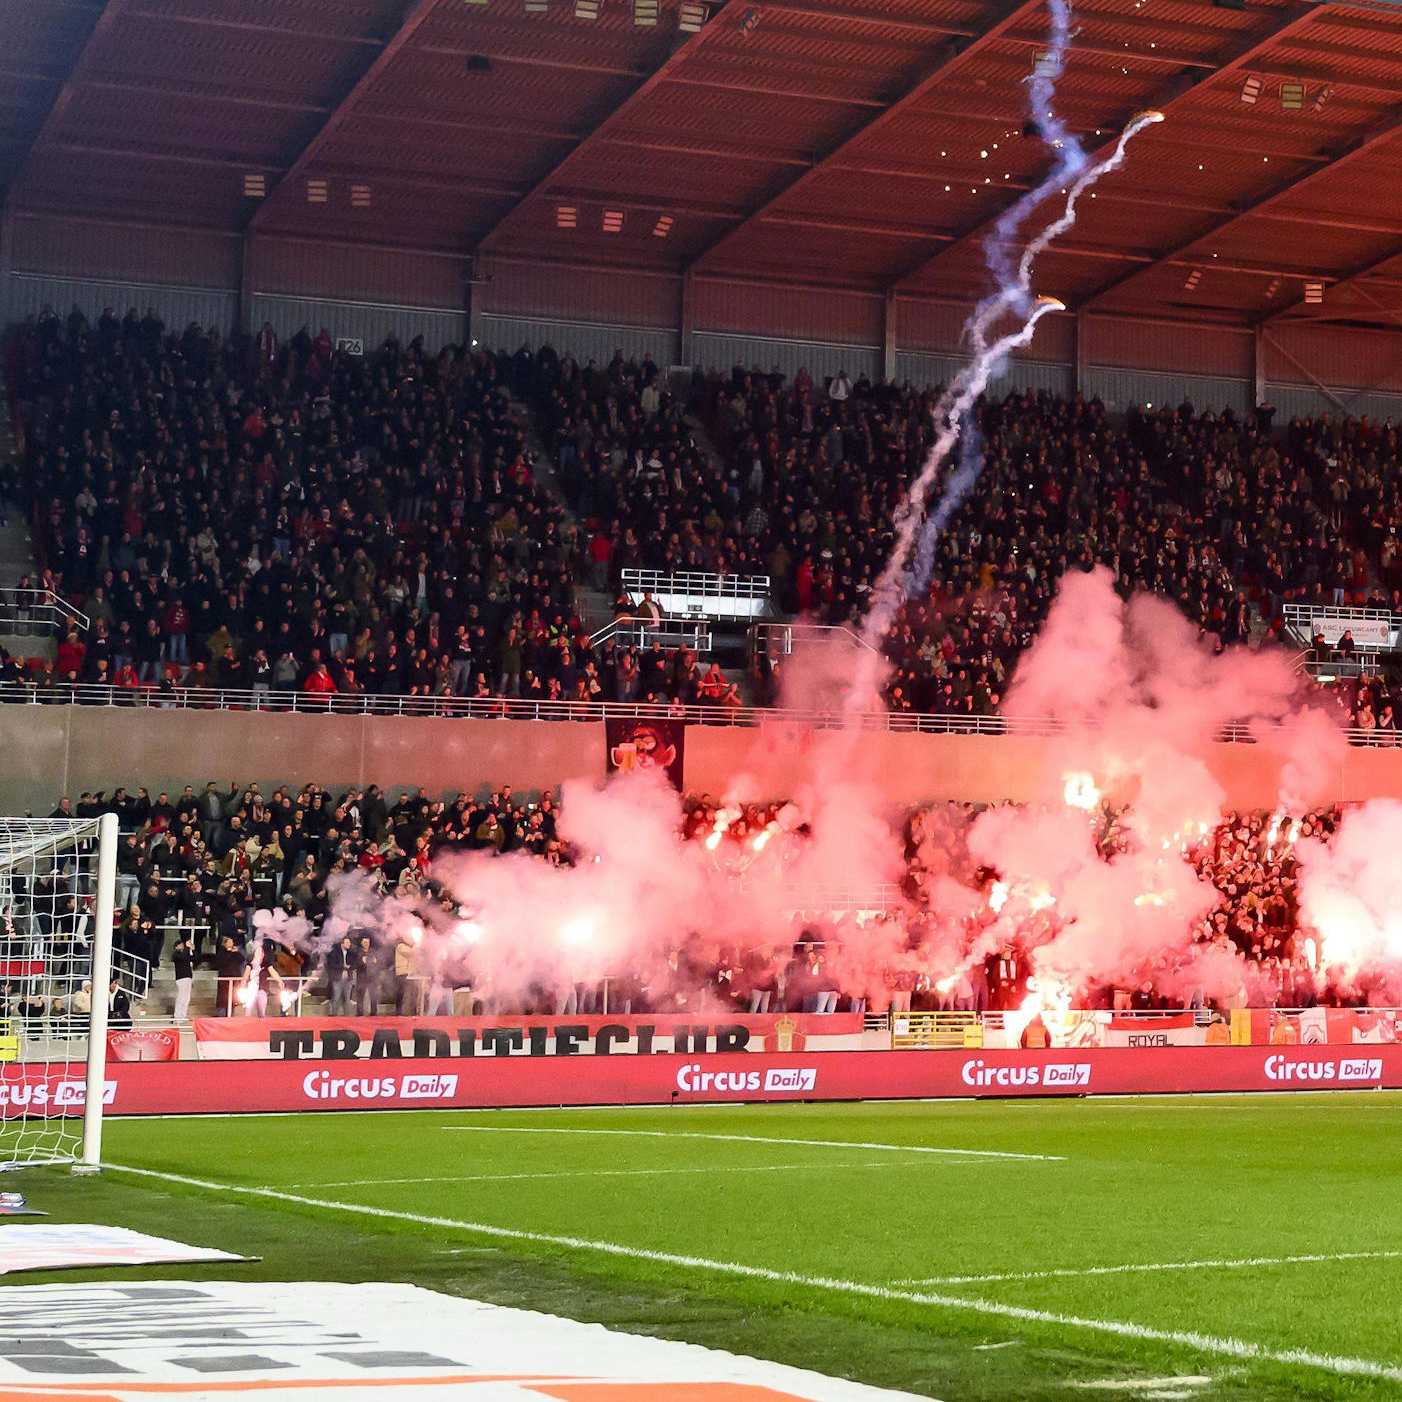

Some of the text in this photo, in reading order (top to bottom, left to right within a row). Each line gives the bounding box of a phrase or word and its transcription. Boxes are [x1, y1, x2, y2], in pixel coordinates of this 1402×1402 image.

[149, 1031, 172, 1045] OLD
[1128, 1035, 1174, 1047] ROYAL
[676, 1064, 811, 1092] Circus Daily
[962, 1059, 1086, 1086] Circus Daily
[1263, 1055, 1378, 1080] Circus Daily
[0, 1084, 48, 1106] cus
[302, 1070, 452, 1099] Circus Daily
